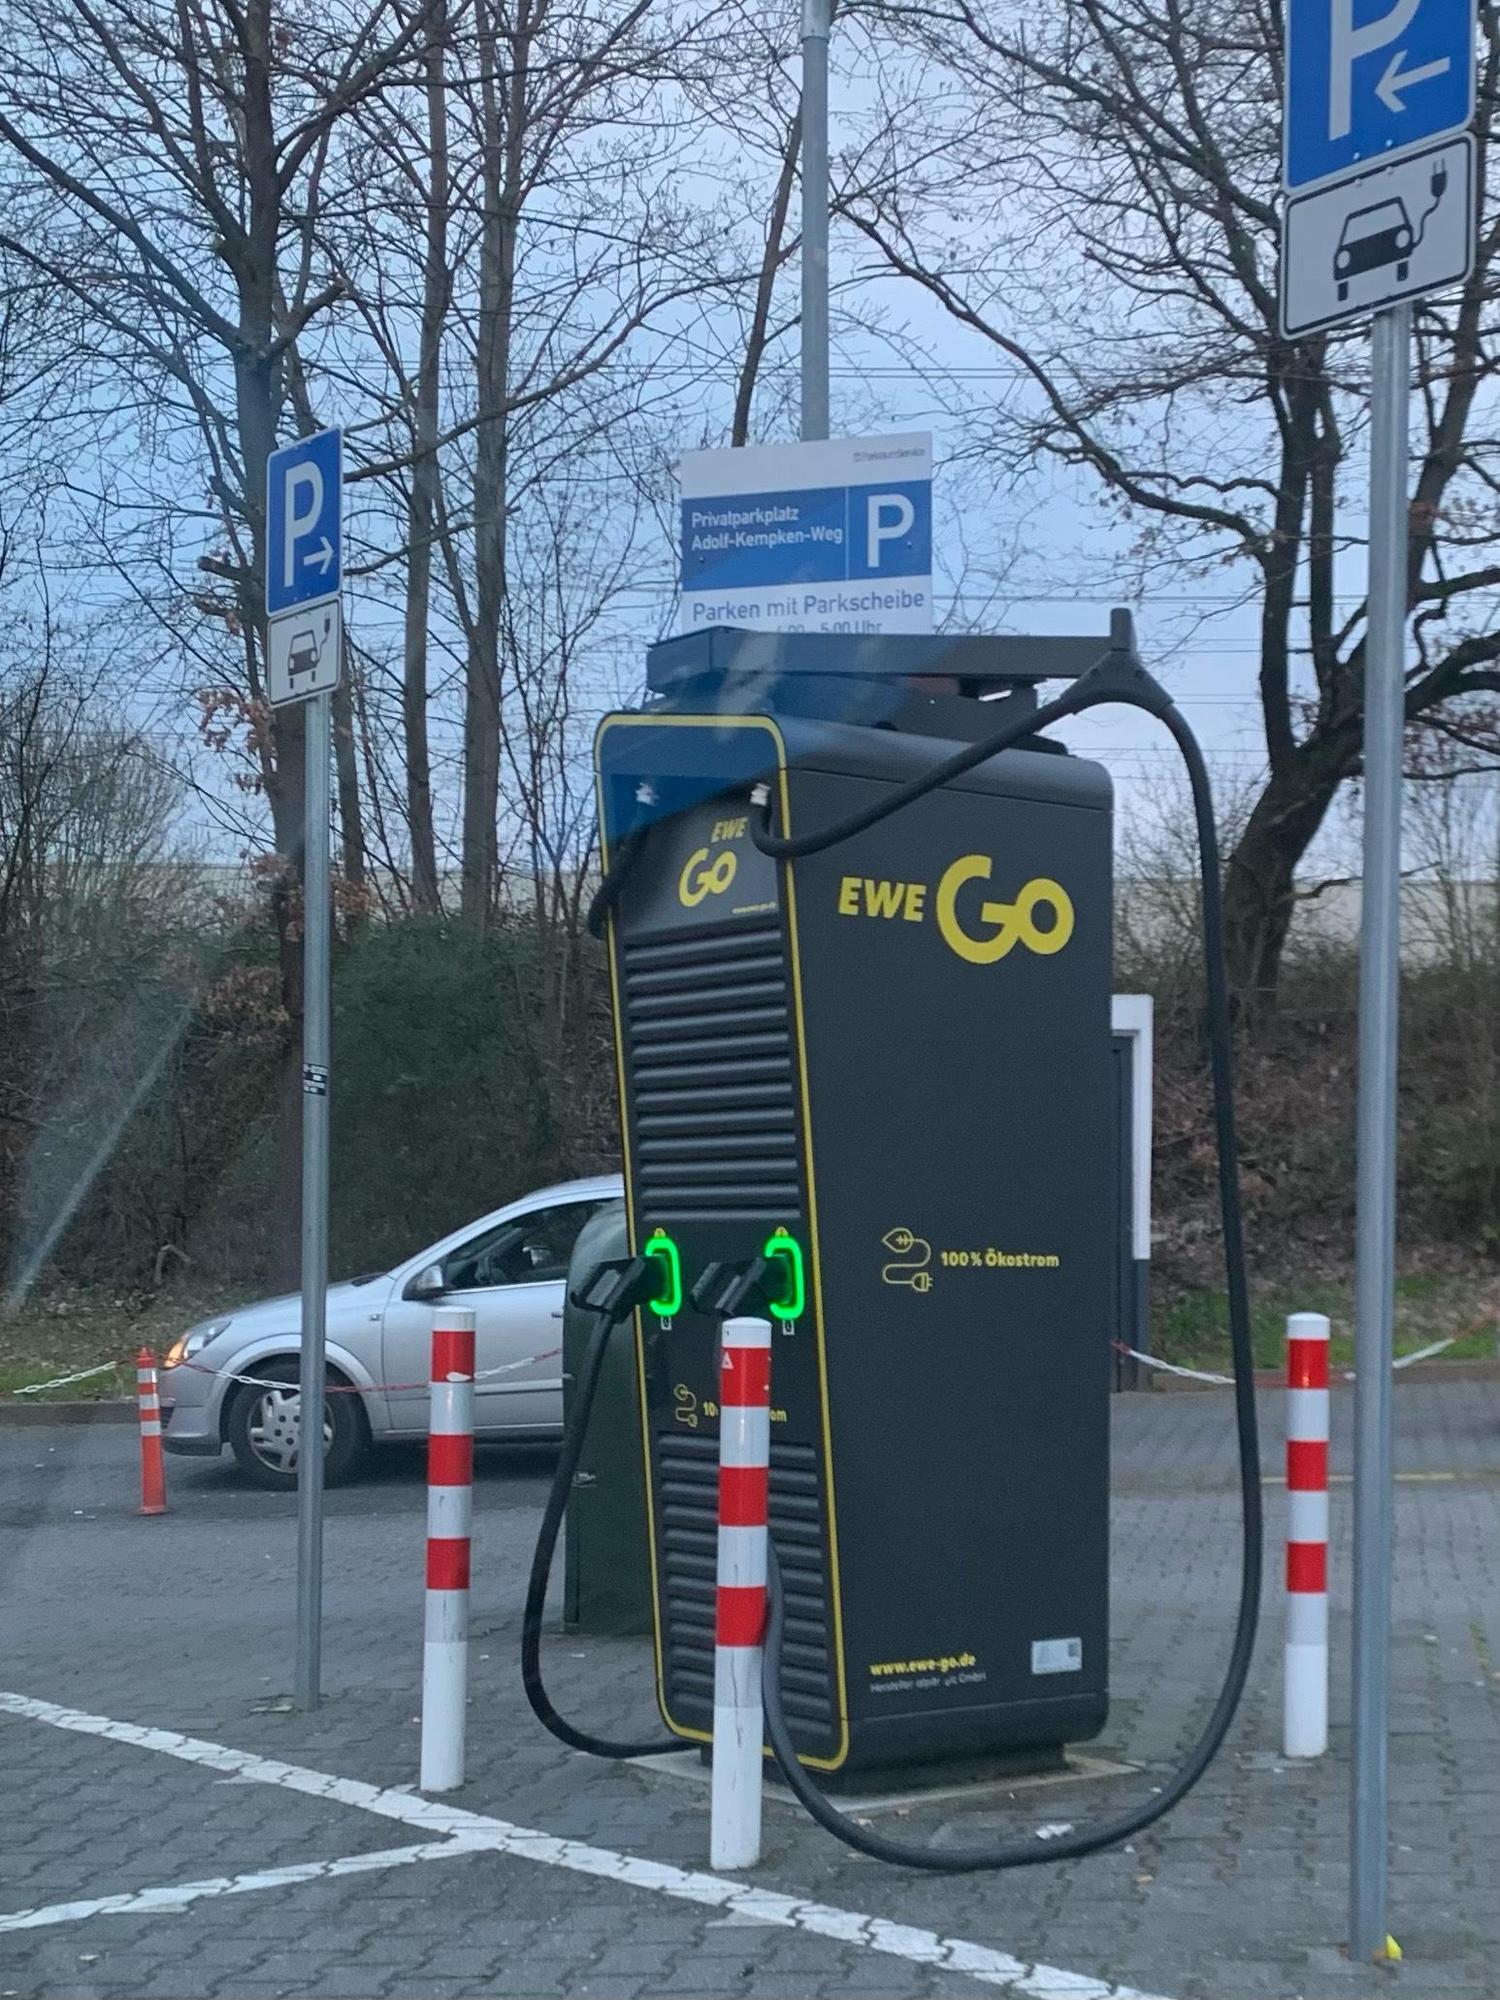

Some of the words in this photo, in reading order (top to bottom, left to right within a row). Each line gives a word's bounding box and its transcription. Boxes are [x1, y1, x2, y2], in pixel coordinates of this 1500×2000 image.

[1328, 0, 1421, 141] P
[283, 460, 324, 588] P
[691, 506, 799, 529] Privatparkplatz
[867, 493, 915, 568] P
[691, 526, 843, 550] Adolf-Kempken-Weg
[693, 599, 760, 622] Parken
[767, 597, 797, 617] mit
[803, 590, 924, 615] Parkscheibe
[711, 816, 749, 843] EWE
[838, 876, 927, 922] EWE
[985, 1248, 1059, 1267] Ökostrom
[869, 1653, 976, 1676] www.ewe-go.de
